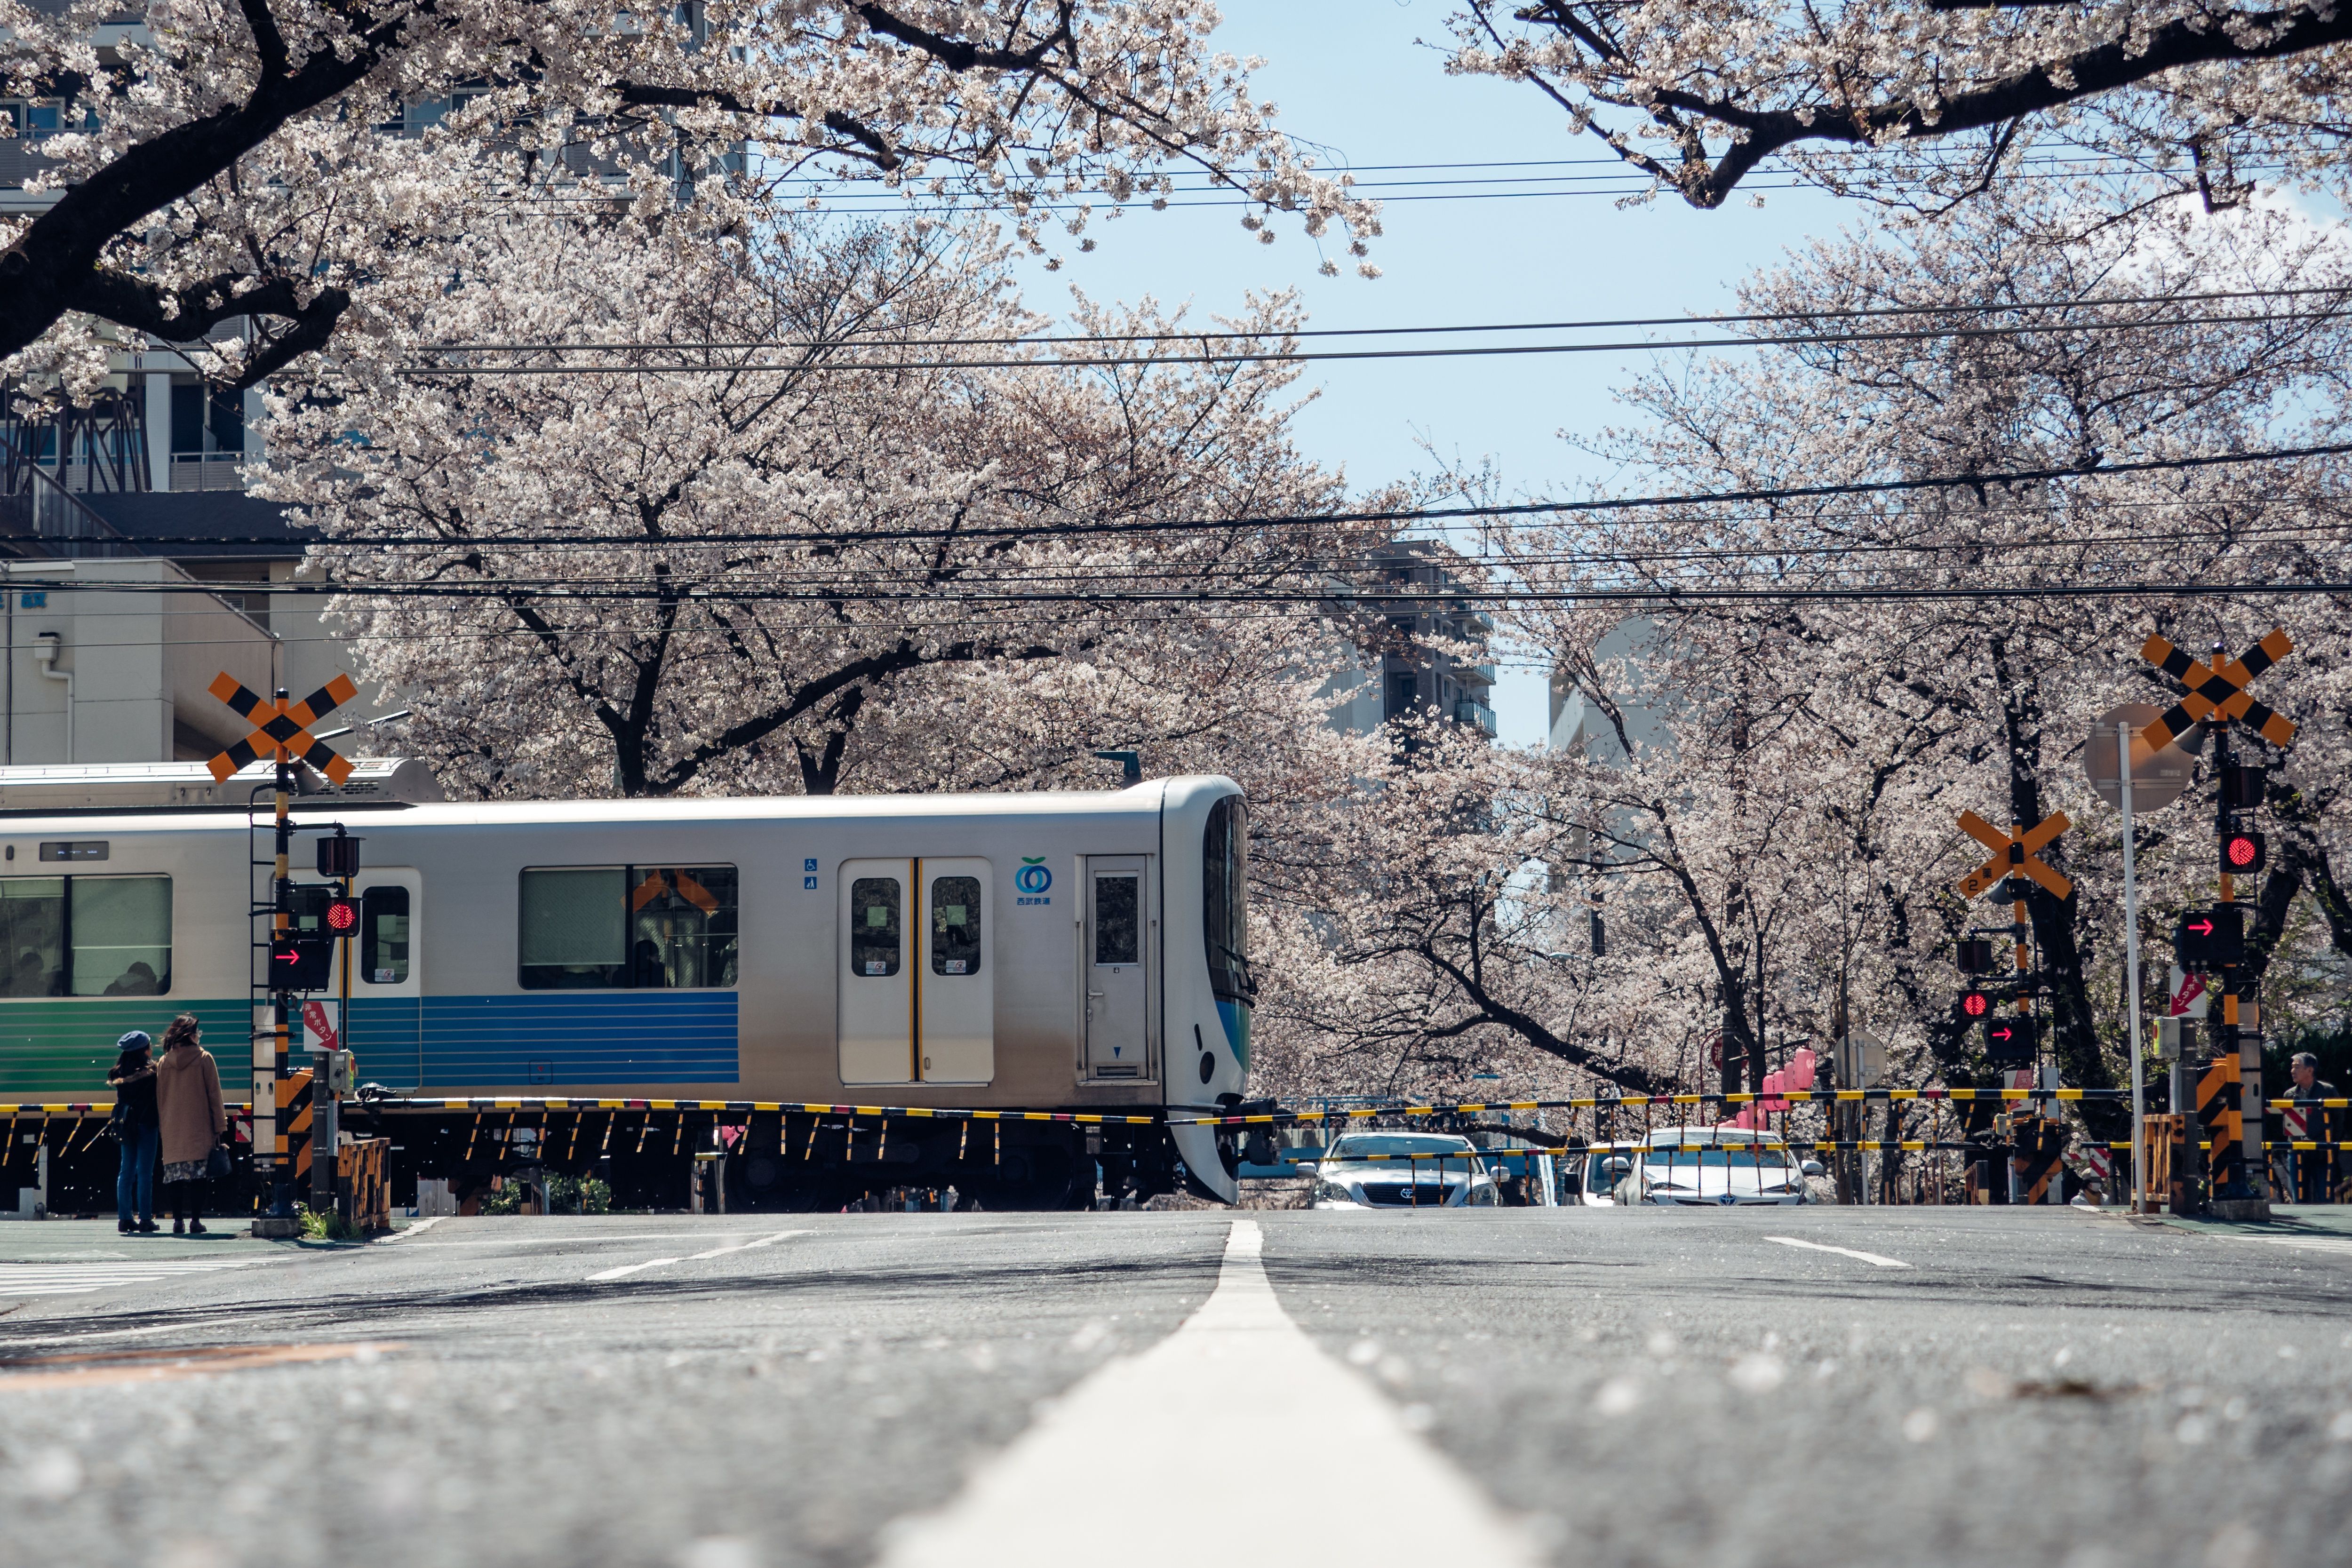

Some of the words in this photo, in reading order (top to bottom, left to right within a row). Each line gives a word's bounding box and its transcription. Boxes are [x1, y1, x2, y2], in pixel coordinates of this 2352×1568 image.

[305, 1003, 332, 1041] 非常ボタン
